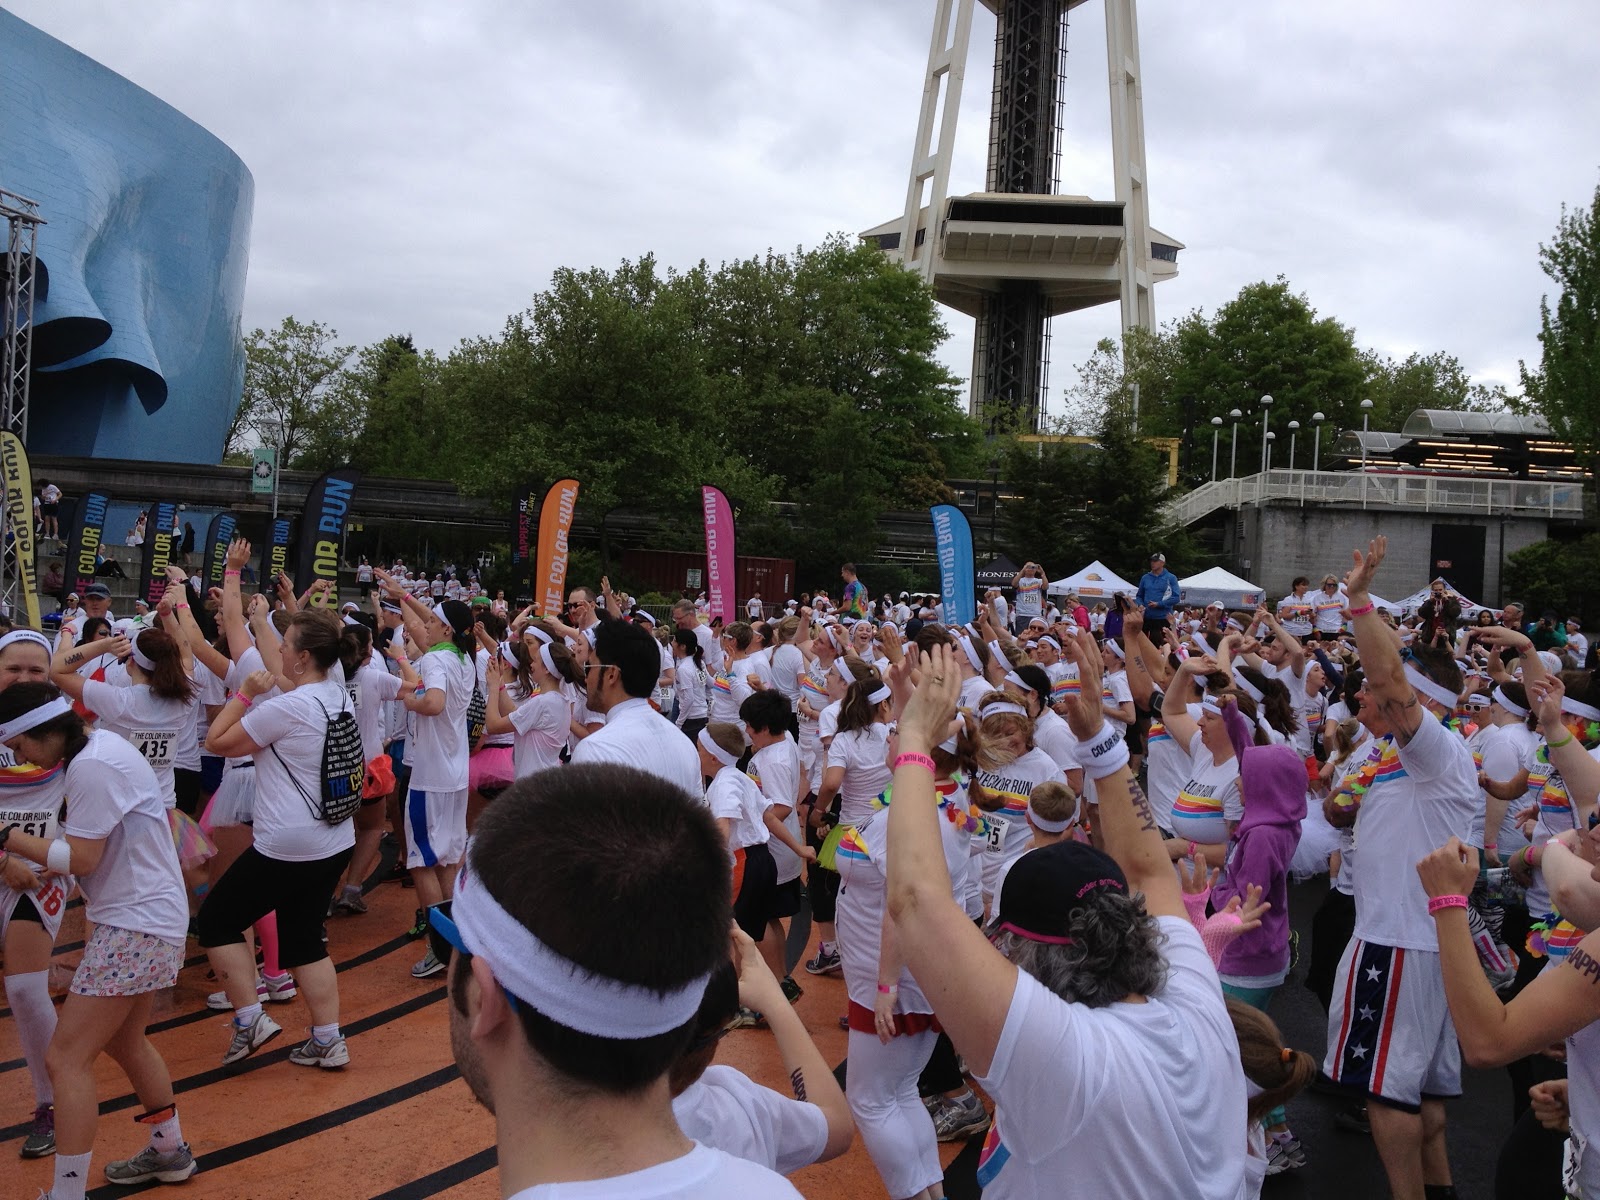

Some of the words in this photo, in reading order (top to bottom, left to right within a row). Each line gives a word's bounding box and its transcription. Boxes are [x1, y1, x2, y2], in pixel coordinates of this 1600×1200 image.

[85, 493, 108, 525] RUN
[157, 502, 176, 531] RUN
[319, 477, 355, 535] RUN
[520, 499, 528, 511] 5K
[217, 515, 236, 541] RUN
[274, 519, 290, 544] RUN
[549, 528, 569, 585] COLOR
[559, 487, 576, 525] RUN
[78, 526, 101, 575] COLOR
[151, 532, 172, 577] COLOR
[211, 542, 228, 582] COLOR
[270, 545, 287, 577] OLOR
[134, 732, 145, 740] THE
[145, 732, 162, 740] COLOR
[1091, 737, 1114, 758] COLOR
[328, 776, 349, 798] THE
[1011, 779, 1033, 796] RUN
[8, 811, 33, 821] COLOR
[33, 811, 48, 821] RUN
[1127, 778, 1157, 832] HAPPY
[1076, 880, 1098, 899] under
[1099, 878, 1123, 890] armour
